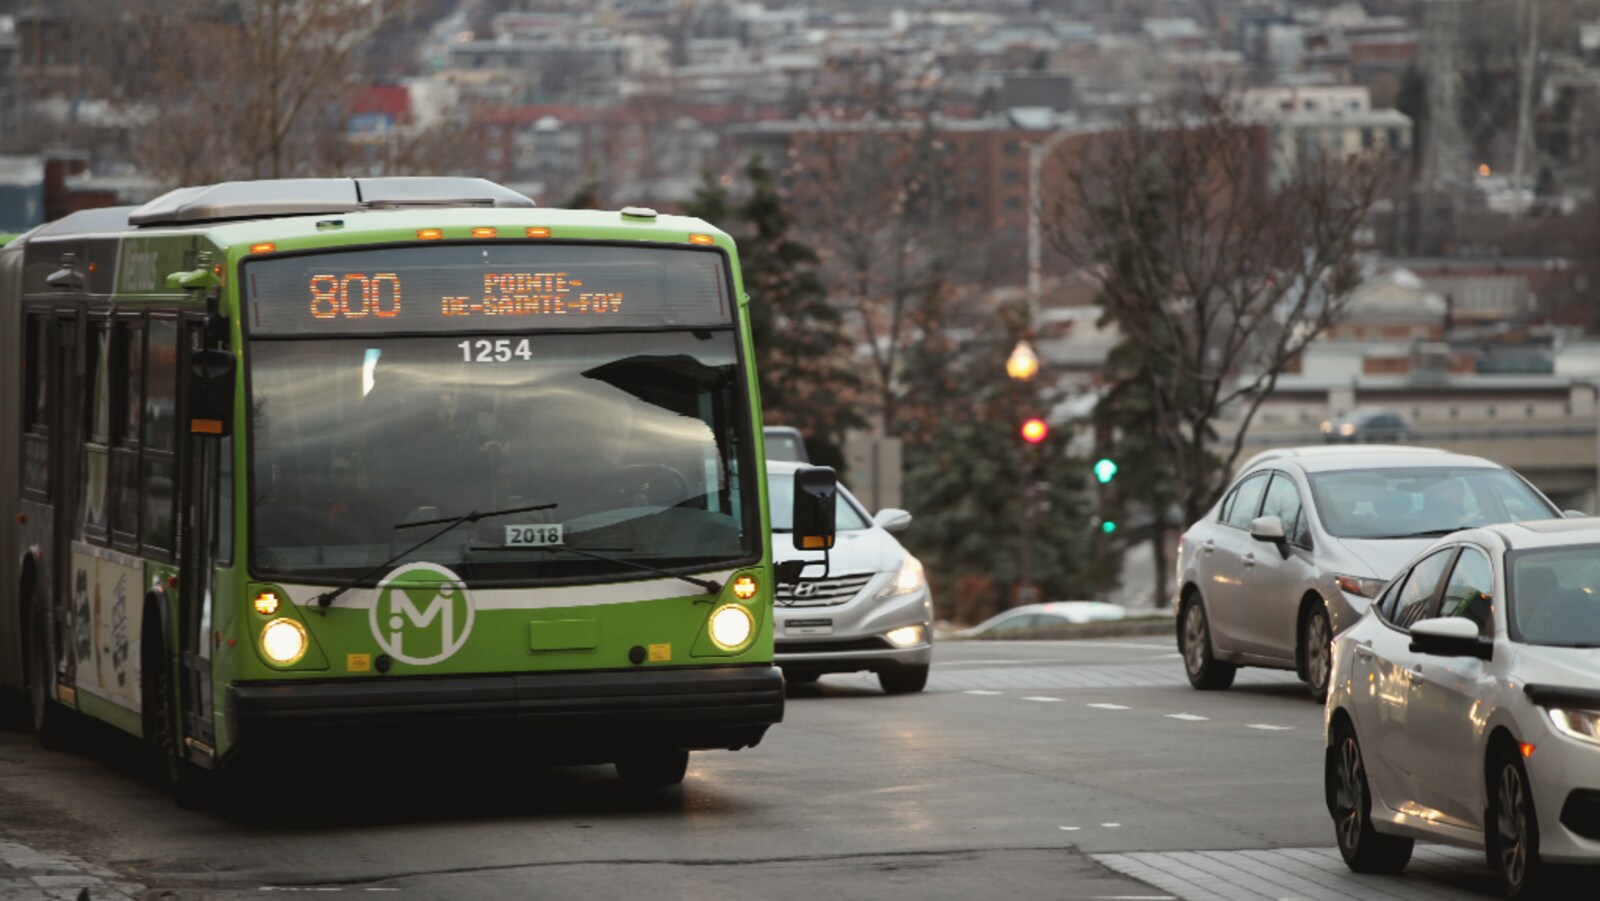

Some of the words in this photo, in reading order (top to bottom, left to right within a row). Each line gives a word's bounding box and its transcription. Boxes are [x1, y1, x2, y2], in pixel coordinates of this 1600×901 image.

[484, 272, 583, 293] POINTE-
[309, 273, 401, 319] 800
[442, 293, 623, 317] DE-SAINTE-FOY
[457, 338, 533, 363] 1254
[511, 527, 559, 544] 2018
